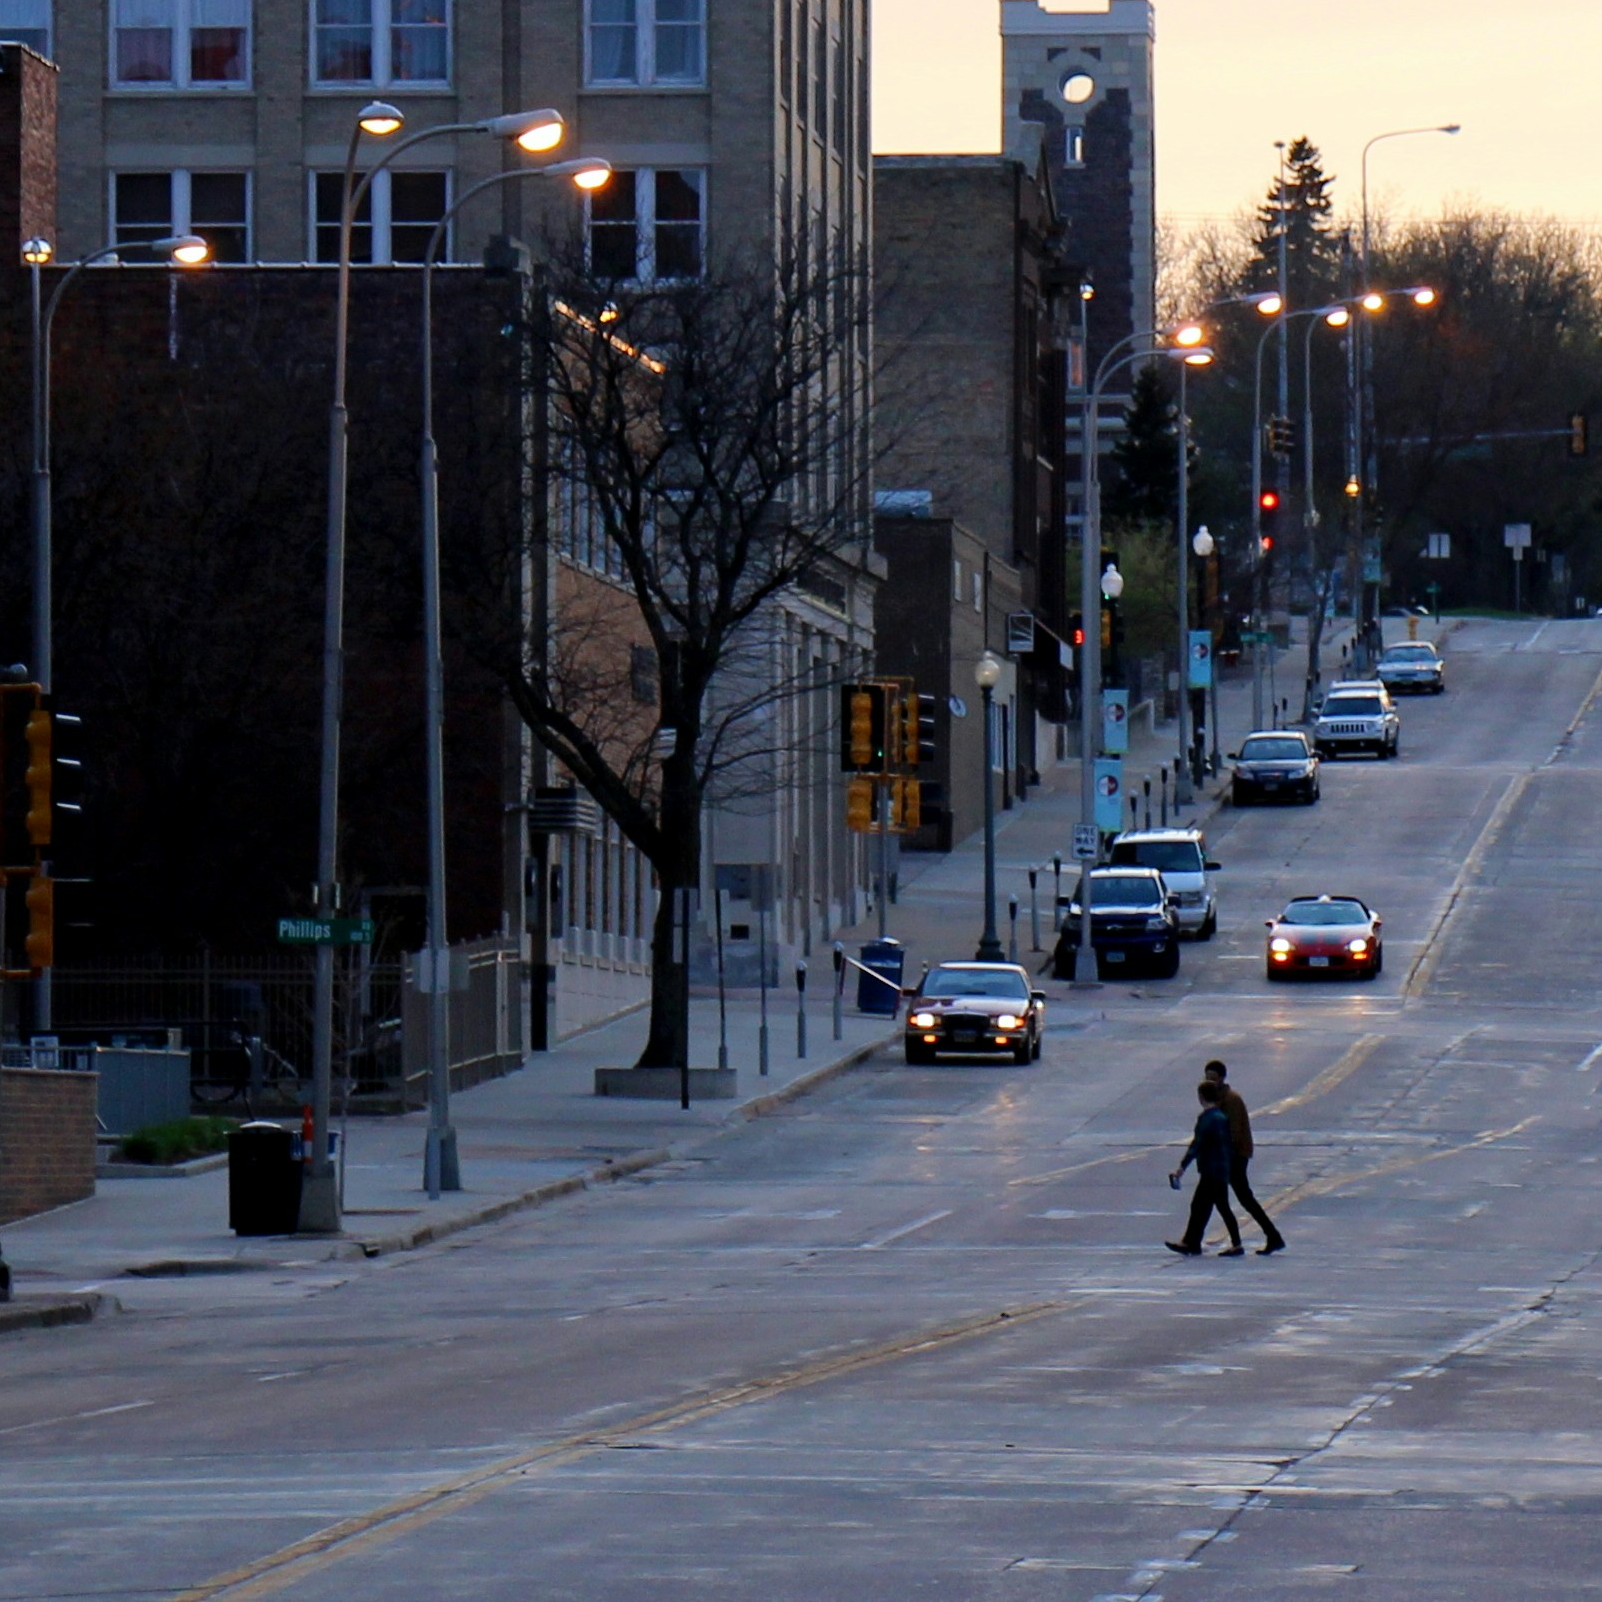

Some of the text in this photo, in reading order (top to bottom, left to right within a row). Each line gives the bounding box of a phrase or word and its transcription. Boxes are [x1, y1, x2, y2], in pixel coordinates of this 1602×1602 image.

[1076, 826, 1096, 836] ONE
[1075, 836, 1096, 845] WAY
[279, 920, 331, 941] Phillips
